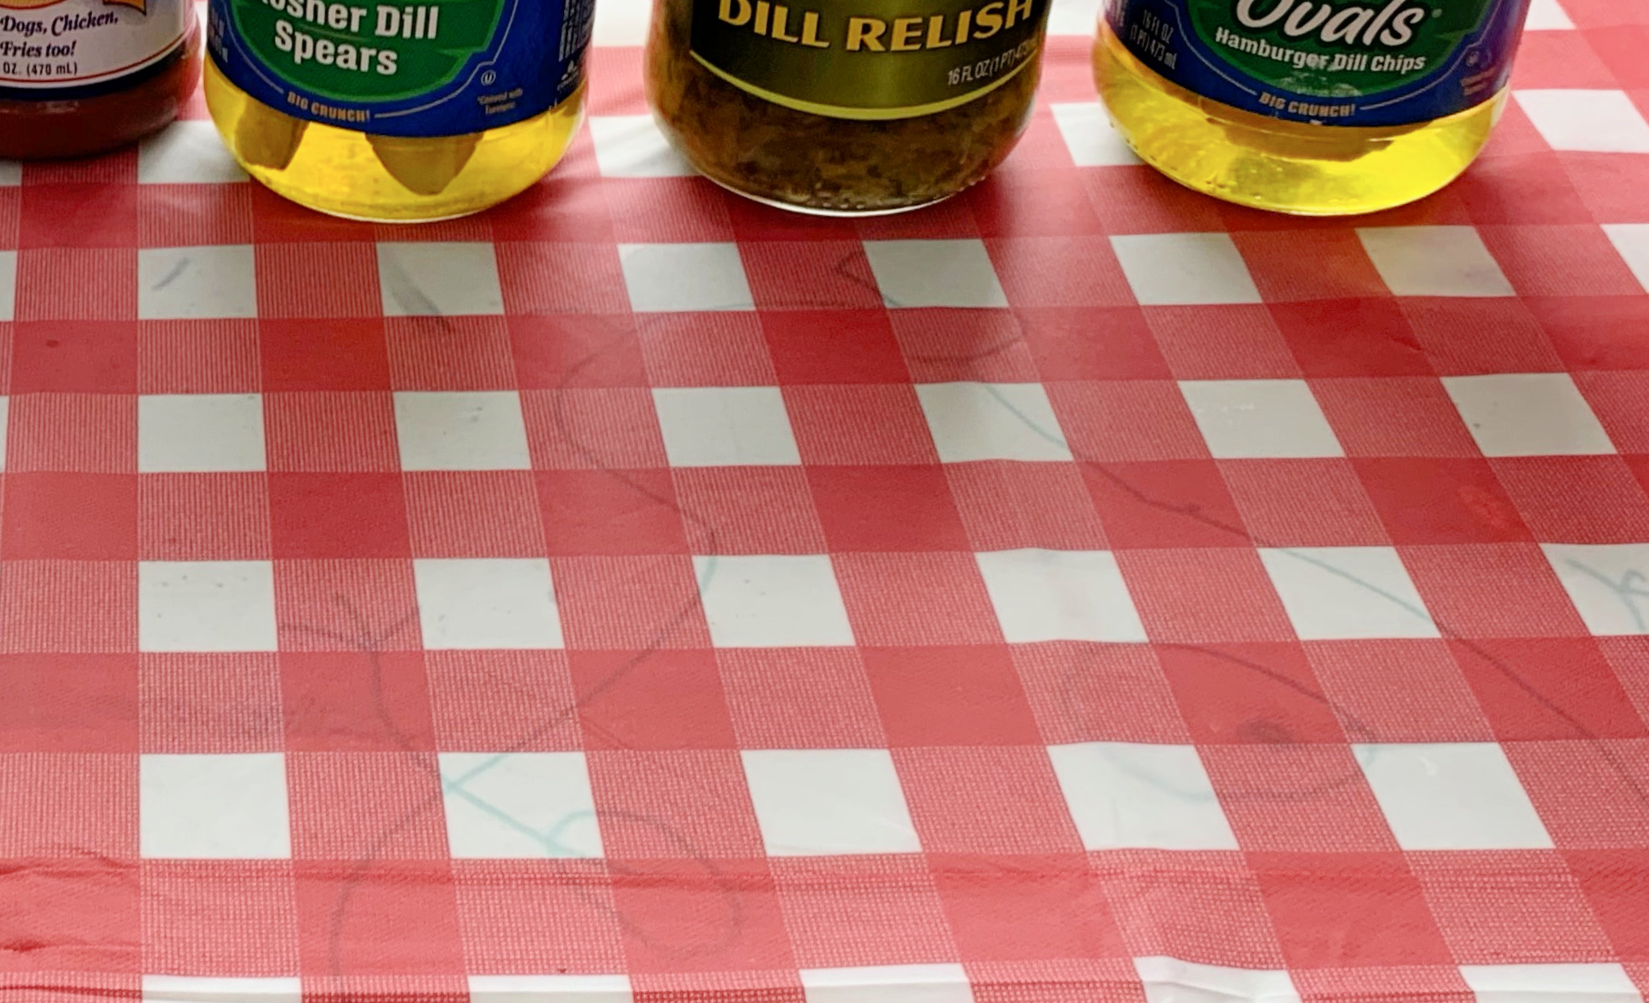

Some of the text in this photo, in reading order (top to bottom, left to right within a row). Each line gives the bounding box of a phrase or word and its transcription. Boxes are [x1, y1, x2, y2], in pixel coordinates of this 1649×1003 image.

[0, 14, 48, 37] Dogs,
[51, 9, 119, 35] Chicken,
[375, 4, 440, 40] Dill
[1142, 9, 1152, 29] 16
[1161, 23, 1174, 44] OZ
[0, 38, 43, 58] Fries
[45, 41, 76, 58] too!
[274, 20, 398, 75] Spears
[1215, 26, 1426, 74] Hamburger Dill Chips
[26, 60, 53, 77] (470
[56, 60, 78, 77] mL)
[946, 67, 961, 88] 16
[960, 64, 974, 84] FL
[286, 90, 371, 123] BIG CRUNCH!
[1259, 92, 1357, 117] BIG CRUNCH!
